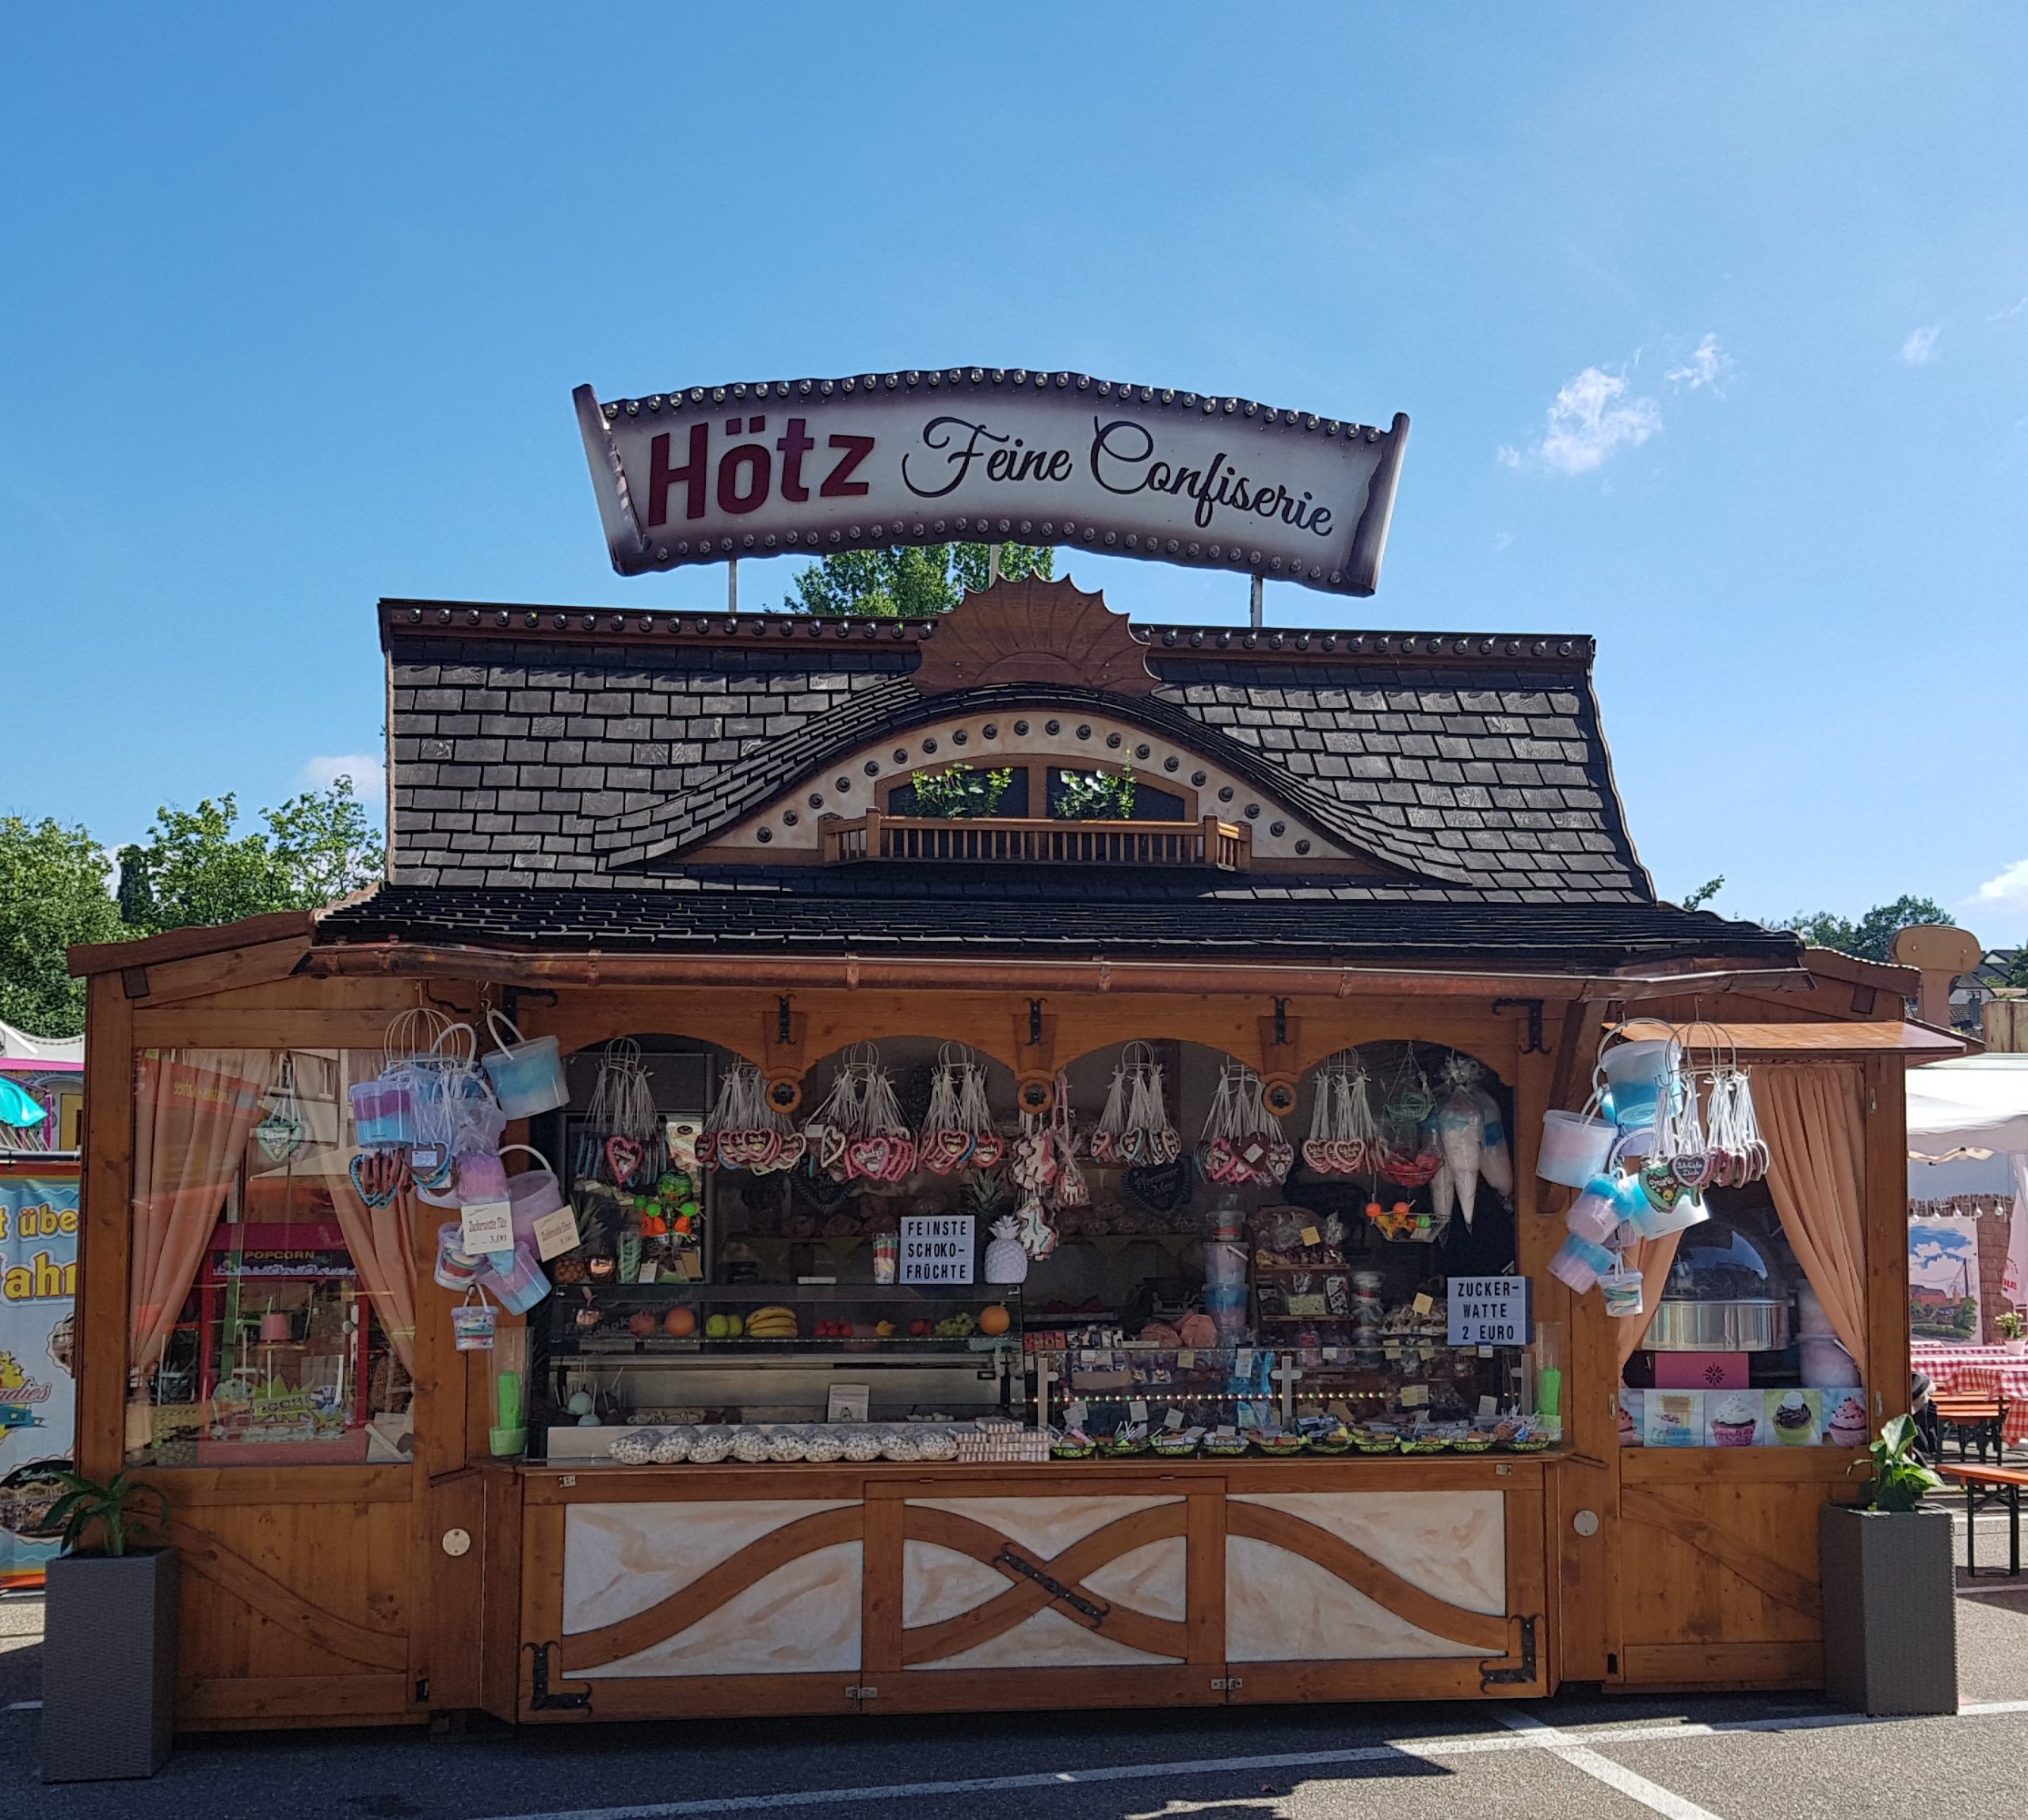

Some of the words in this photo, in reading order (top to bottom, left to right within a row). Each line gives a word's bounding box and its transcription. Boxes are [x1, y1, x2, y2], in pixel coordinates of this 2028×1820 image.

[649, 415, 875, 527] Hötz
[902, 417, 1073, 498] Feine
[1090, 416, 1333, 536] Confiserie
[908, 1220, 966, 1236] FEINSTE
[490, 1233, 507, 1245] 3,00
[244, 1250, 314, 1260] POPCORN
[908, 1243, 966, 1258] SCHOKO-
[906, 1263, 966, 1280] FRÜCHTE
[1458, 1281, 1519, 1297] ZUCKER-
[1463, 1303, 1508, 1319] WATTE
[1462, 1325, 1470, 1340] 2
[1479, 1325, 1515, 1340] EURO
